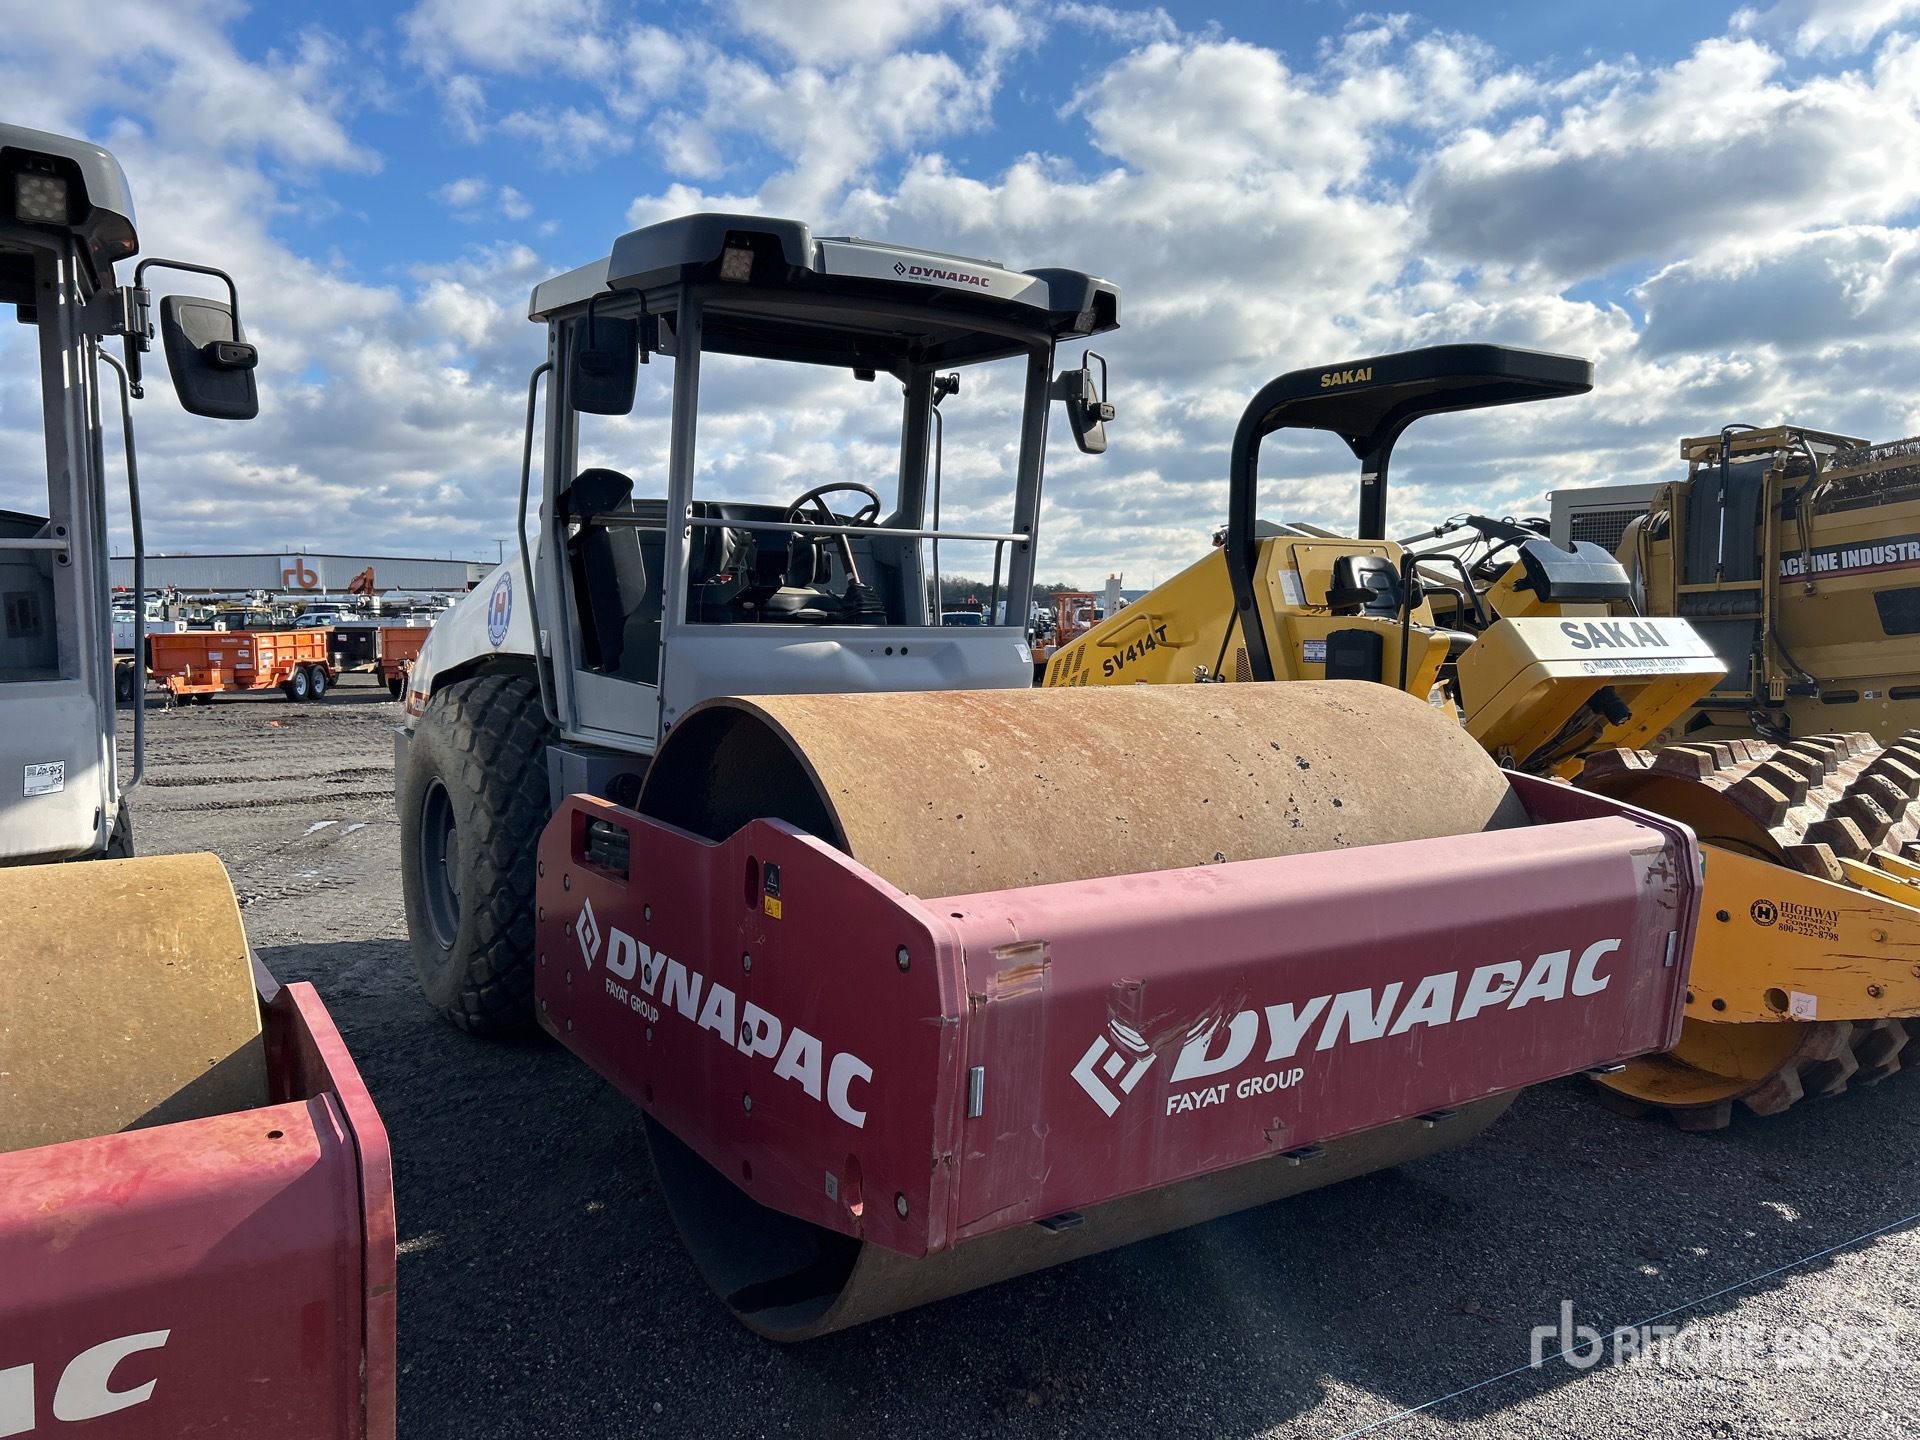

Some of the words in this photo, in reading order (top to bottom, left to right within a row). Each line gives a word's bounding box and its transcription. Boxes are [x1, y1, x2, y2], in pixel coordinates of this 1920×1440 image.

[909, 266, 990, 288] DYNAPAC
[1320, 367, 1372, 388] SAKAI
[1841, 541, 1920, 569] INDUSTR
[282, 558, 318, 589] rb
[1560, 621, 1670, 650] SAKAI
[1102, 623, 1167, 678] SV414T
[1780, 901, 1840, 922] HIGHWAY
[1781, 912, 1838, 928] EQUIPMENT
[1785, 918, 1833, 932] COMPANY
[1778, 922, 1839, 942] 800-222-8798
[605, 977, 629, 1005] FAYAT
[630, 994, 659, 1024] GROUP
[1169, 938, 1622, 1083] DYNAPAC
[605, 925, 874, 1130] DYNAPAC
[1166, 1083, 1230, 1116] FAYAT
[1236, 1067, 1305, 1099] GROUP
